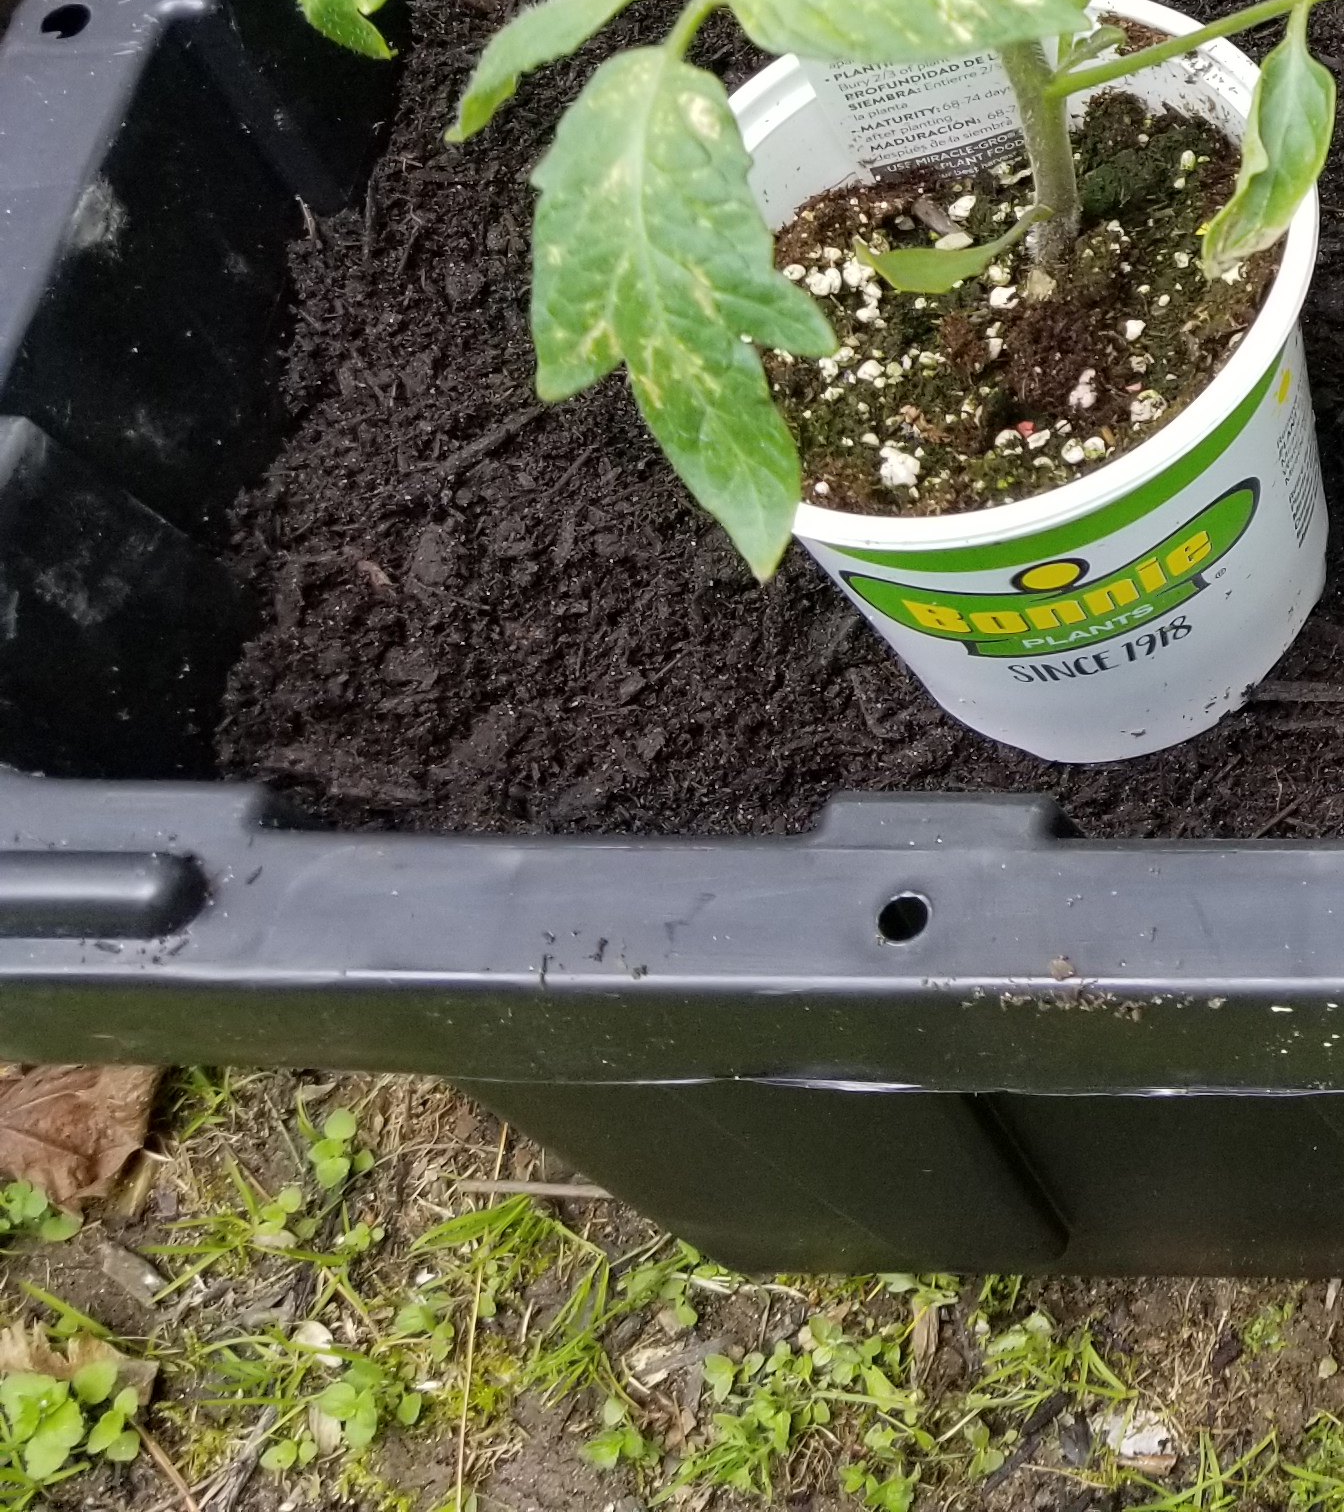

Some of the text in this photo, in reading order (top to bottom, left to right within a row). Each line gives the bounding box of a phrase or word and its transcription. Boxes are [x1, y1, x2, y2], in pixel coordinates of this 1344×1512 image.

[838, 78, 870, 93] Bury
[873, 69, 897, 83] 2/3
[899, 64, 914, 76] of
[844, 64, 960, 102] PROFUNDIDAD
[963, 56, 985, 68] DE
[848, 88, 921, 112] SIEMBRA:
[924, 70, 978, 92] Entierre
[853, 102, 909, 122] la planta
[860, 105, 941, 134] MATURITY:
[942, 94, 982, 112] 68-74
[865, 115, 953, 143] after planting
[869, 105, 1017, 153] MADURACIÓN: 68-7
[886, 161, 912, 173] USE
[939, 138, 1025, 171] PLANT FOOD
[901, 530, 1213, 635] Bonnie
[1021, 603, 1155, 649] PLANTS
[1007, 615, 1193, 683] SINCE 1918
